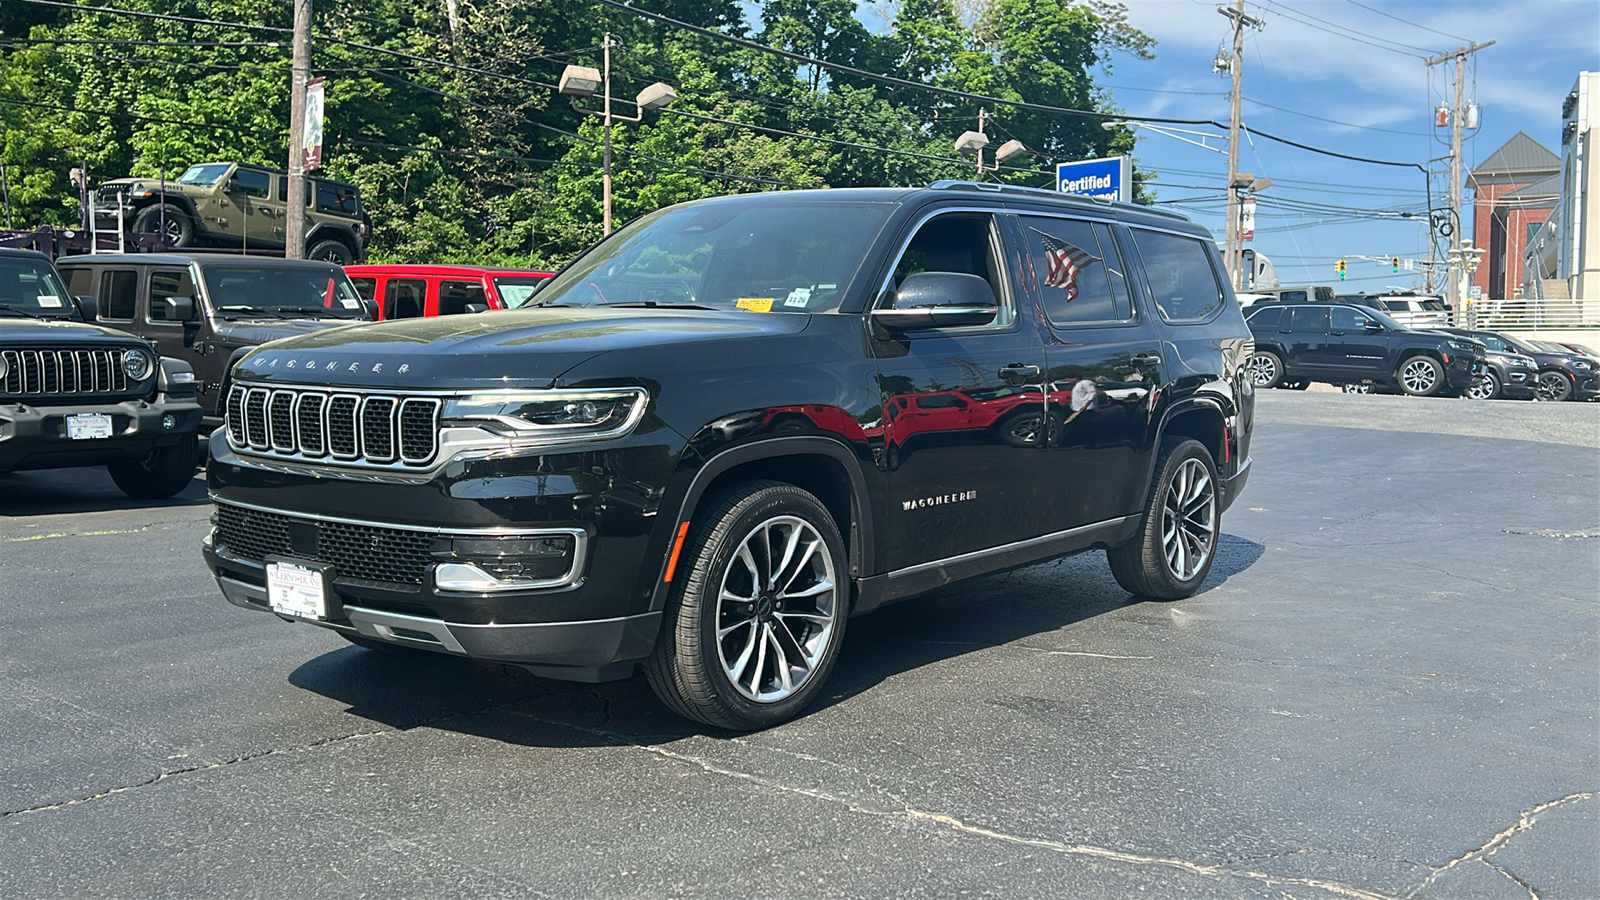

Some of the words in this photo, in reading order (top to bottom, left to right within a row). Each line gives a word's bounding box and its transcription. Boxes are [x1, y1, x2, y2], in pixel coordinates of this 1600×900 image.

[1061, 174, 1111, 193] Certified
[253, 357, 410, 374] WAGONEER
[902, 492, 966, 511] WAGONEER
